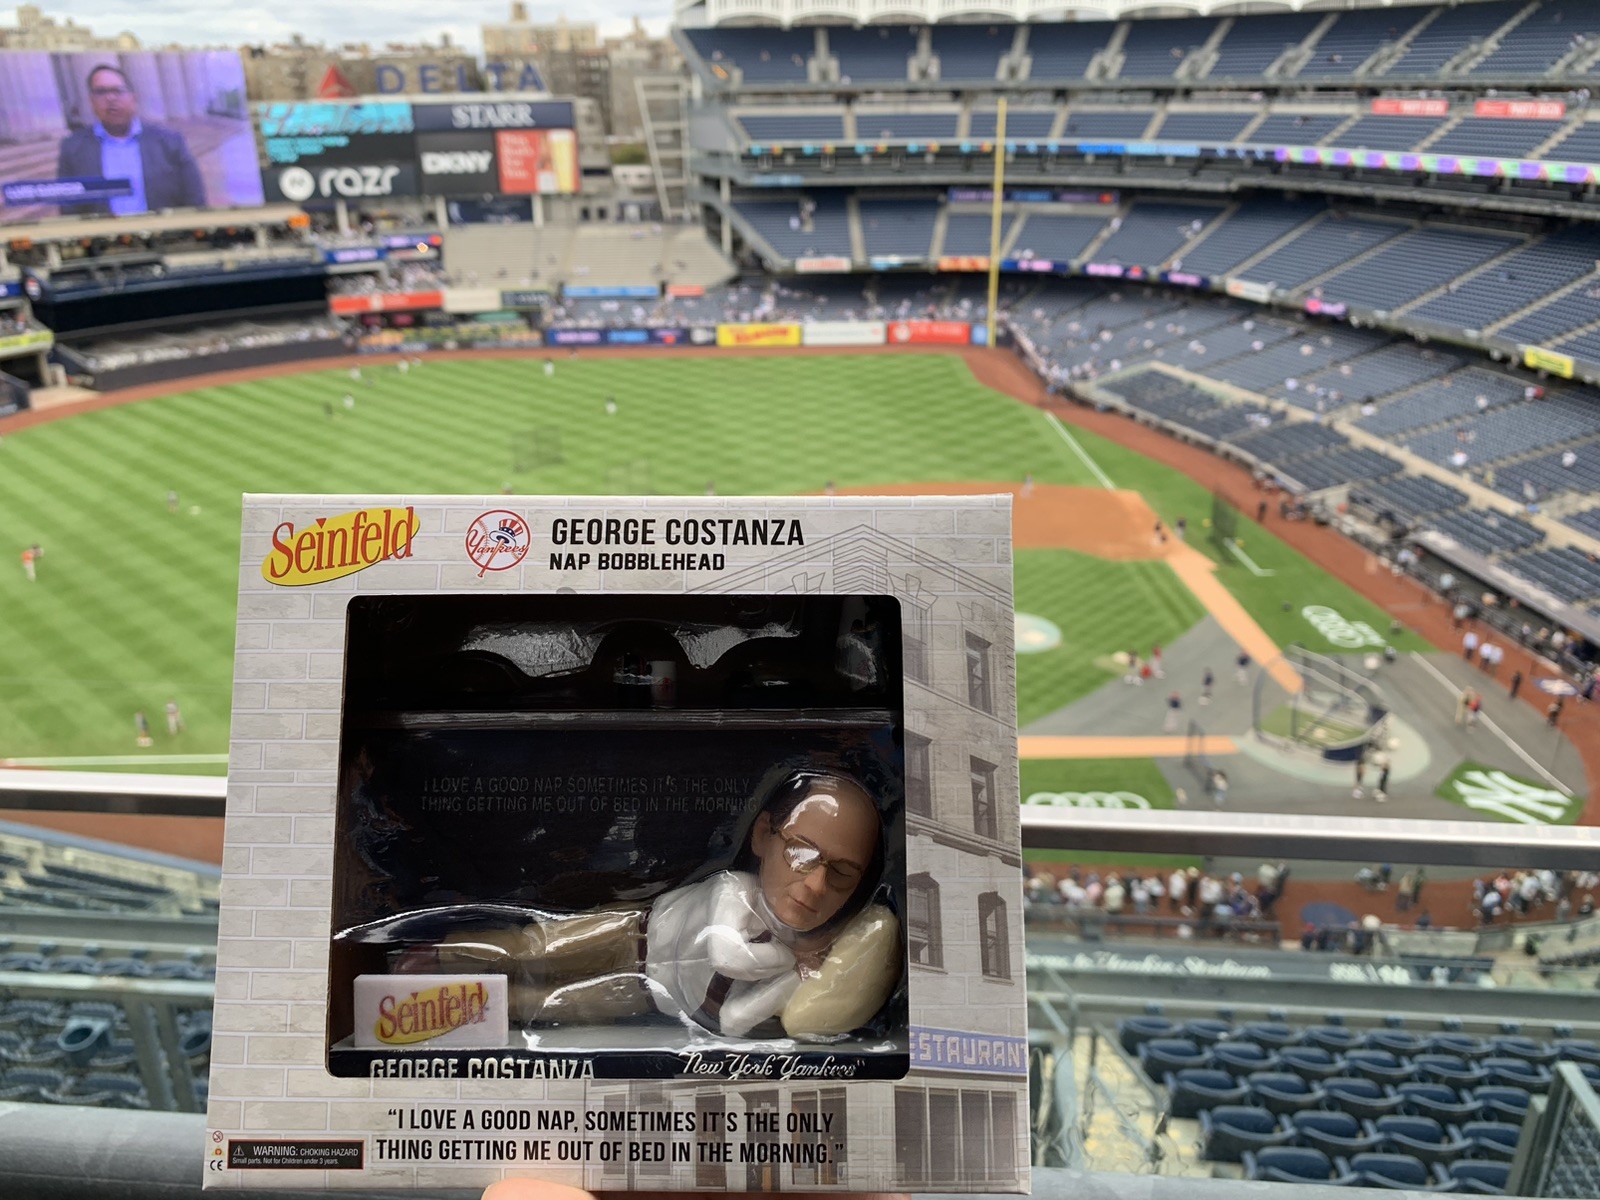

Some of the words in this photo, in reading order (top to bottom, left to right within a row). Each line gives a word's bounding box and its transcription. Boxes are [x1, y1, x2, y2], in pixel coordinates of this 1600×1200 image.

[375, 64, 547, 94] DELTA
[451, 102, 536, 129] STARR
[421, 150, 493, 175] DKNY
[319, 165, 400, 198] razr
[270, 506, 414, 579] Seinfeld
[466, 529, 529, 558] Yankees
[552, 518, 656, 545] GEORGE
[665, 519, 805, 546] COSTANZA
[549, 553, 591, 570] NAP
[598, 553, 725, 570] BOBBLEHEAD
[433, 777, 470, 793] LOVE
[474, 777, 484, 793] A
[488, 777, 531, 793] GOOD
[534, 777, 563, 793] NAP
[567, 777, 648, 794] SOMETIMES
[683, 777, 709, 794] THE
[713, 777, 750, 794] ONLY
[421, 796, 462, 812] THING
[466, 796, 527, 813] GETTING
[532, 796, 553, 813] ME
[556, 796, 587, 813] OUT
[590, 796, 609, 813] OF
[613, 796, 641, 813] BED
[645, 796, 660, 813] IN
[664, 796, 690, 813] THE
[694, 796, 758, 813] MORNING
[379, 982, 486, 1039] Seinfeld
[370, 1057, 458, 1079] GEORGE
[467, 1057, 595, 1079] COSTANZA
[679, 1052, 724, 1074] New
[725, 1054, 776, 1080] York
[410, 1109, 457, 1130] LOVE
[462, 1109, 476, 1130] A
[481, 1110, 531, 1131] GOOD
[537, 1110, 578, 1133] NAP,
[585, 1110, 696, 1132] SOMETIMES
[744, 1112, 780, 1133] THE
[786, 1112, 834, 1133] ONLY
[232, 1156, 248, 1165] Small
[248, 1157, 262, 1165] parts.
[263, 1157, 272, 1165] Not
[273, 1157, 281, 1165] for
[281, 1157, 304, 1165] Children
[304, 1157, 319, 1165] under
[324, 1157, 339, 1166] years.
[253, 1145, 299, 1156] WARNING:
[300, 1147, 331, 1157] CHOKING
[331, 1147, 359, 1157] HAZARD
[376, 1138, 432, 1160] THING
[438, 1139, 517, 1160] GETTING
[523, 1140, 551, 1161] ME
[557, 1140, 594, 1161] OUT
[599, 1141, 623, 1162] OF
[629, 1141, 666, 1162] BED
[672, 1141, 691, 1162] IN
[697, 1142, 733, 1163] THE
